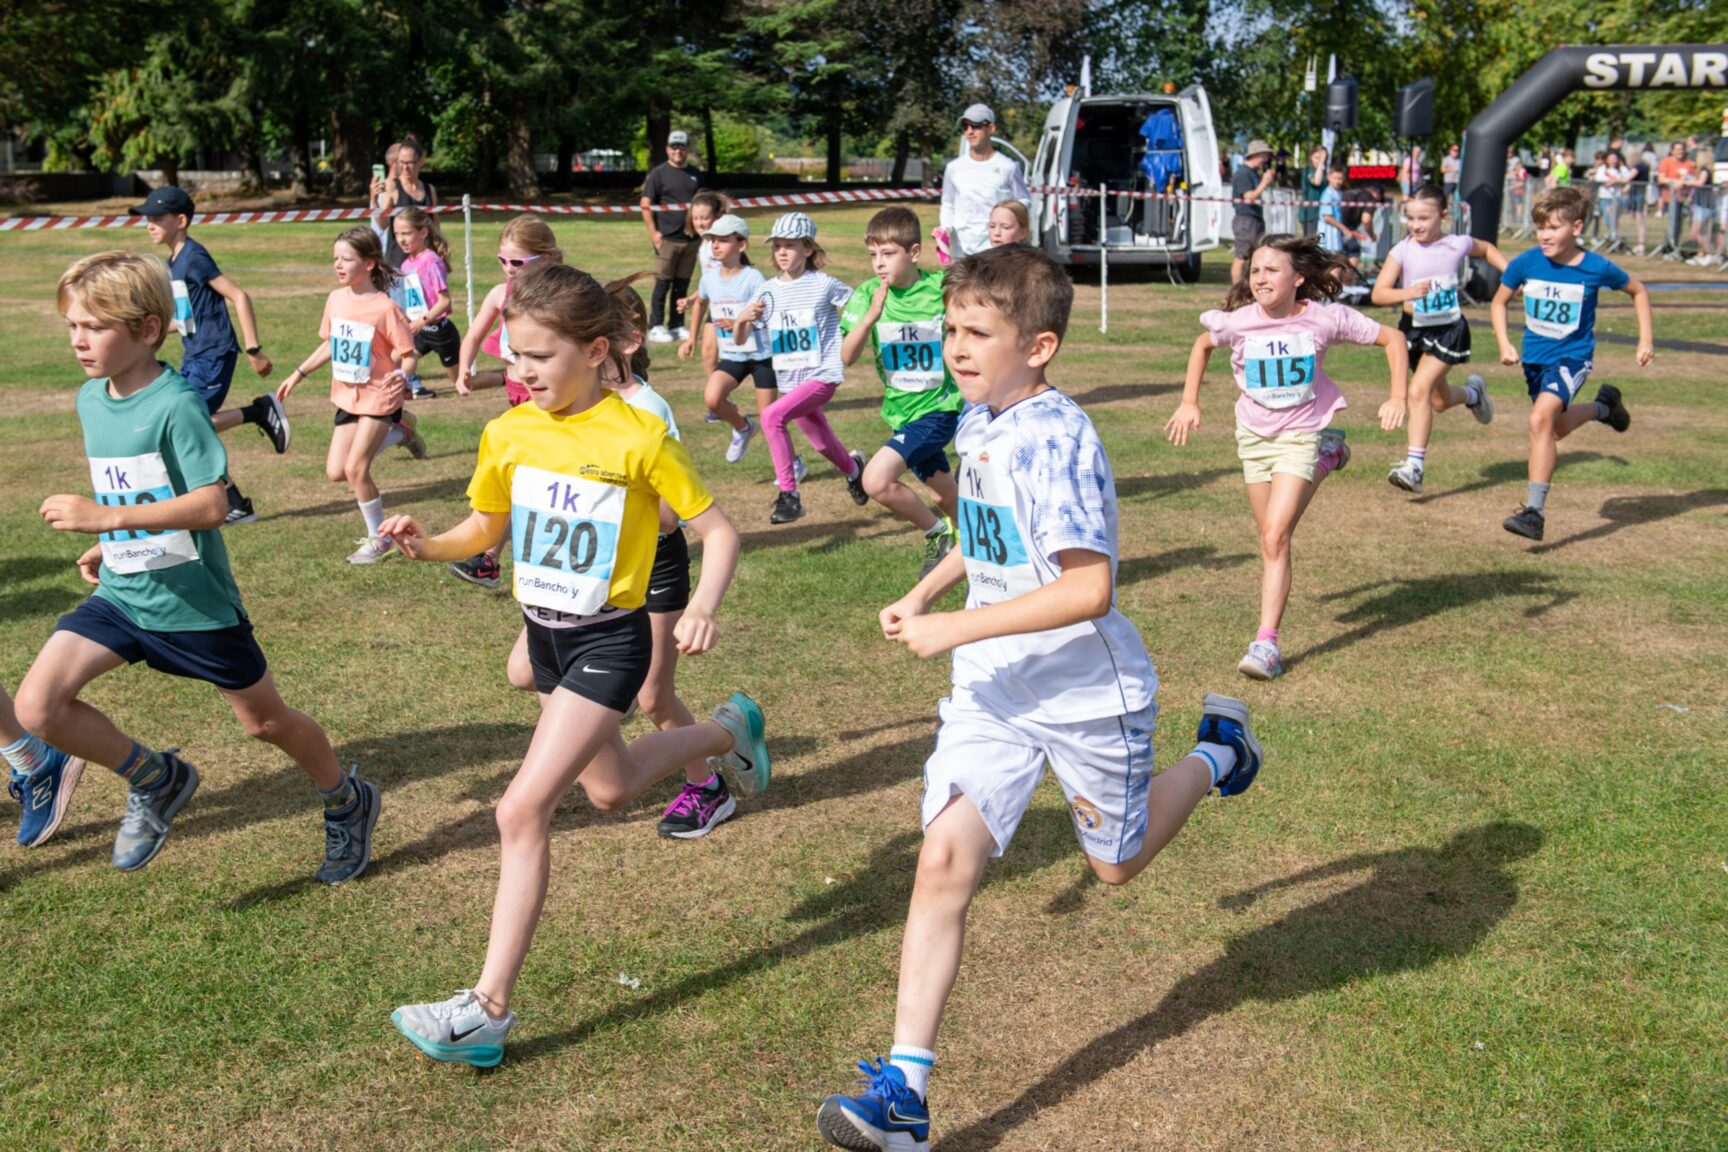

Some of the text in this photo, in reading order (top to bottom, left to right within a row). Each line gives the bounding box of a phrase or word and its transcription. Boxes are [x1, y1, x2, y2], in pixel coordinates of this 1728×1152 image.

[1544, 286, 1562, 299] 1k
[781, 310, 798, 327] 1k
[1533, 298, 1571, 324] 128
[340, 324, 354, 338] 1k
[779, 329, 812, 353] 108
[898, 327, 919, 341] 1k
[333, 337, 364, 366] 134
[891, 344, 934, 371] 130
[1266, 341, 1290, 356] 1k
[1258, 357, 1306, 388] 115
[105, 465, 131, 490] 1k
[966, 467, 985, 499] 1k
[547, 481, 581, 513] 1k
[521, 510, 598, 574] 120
[963, 502, 1008, 566] 143
